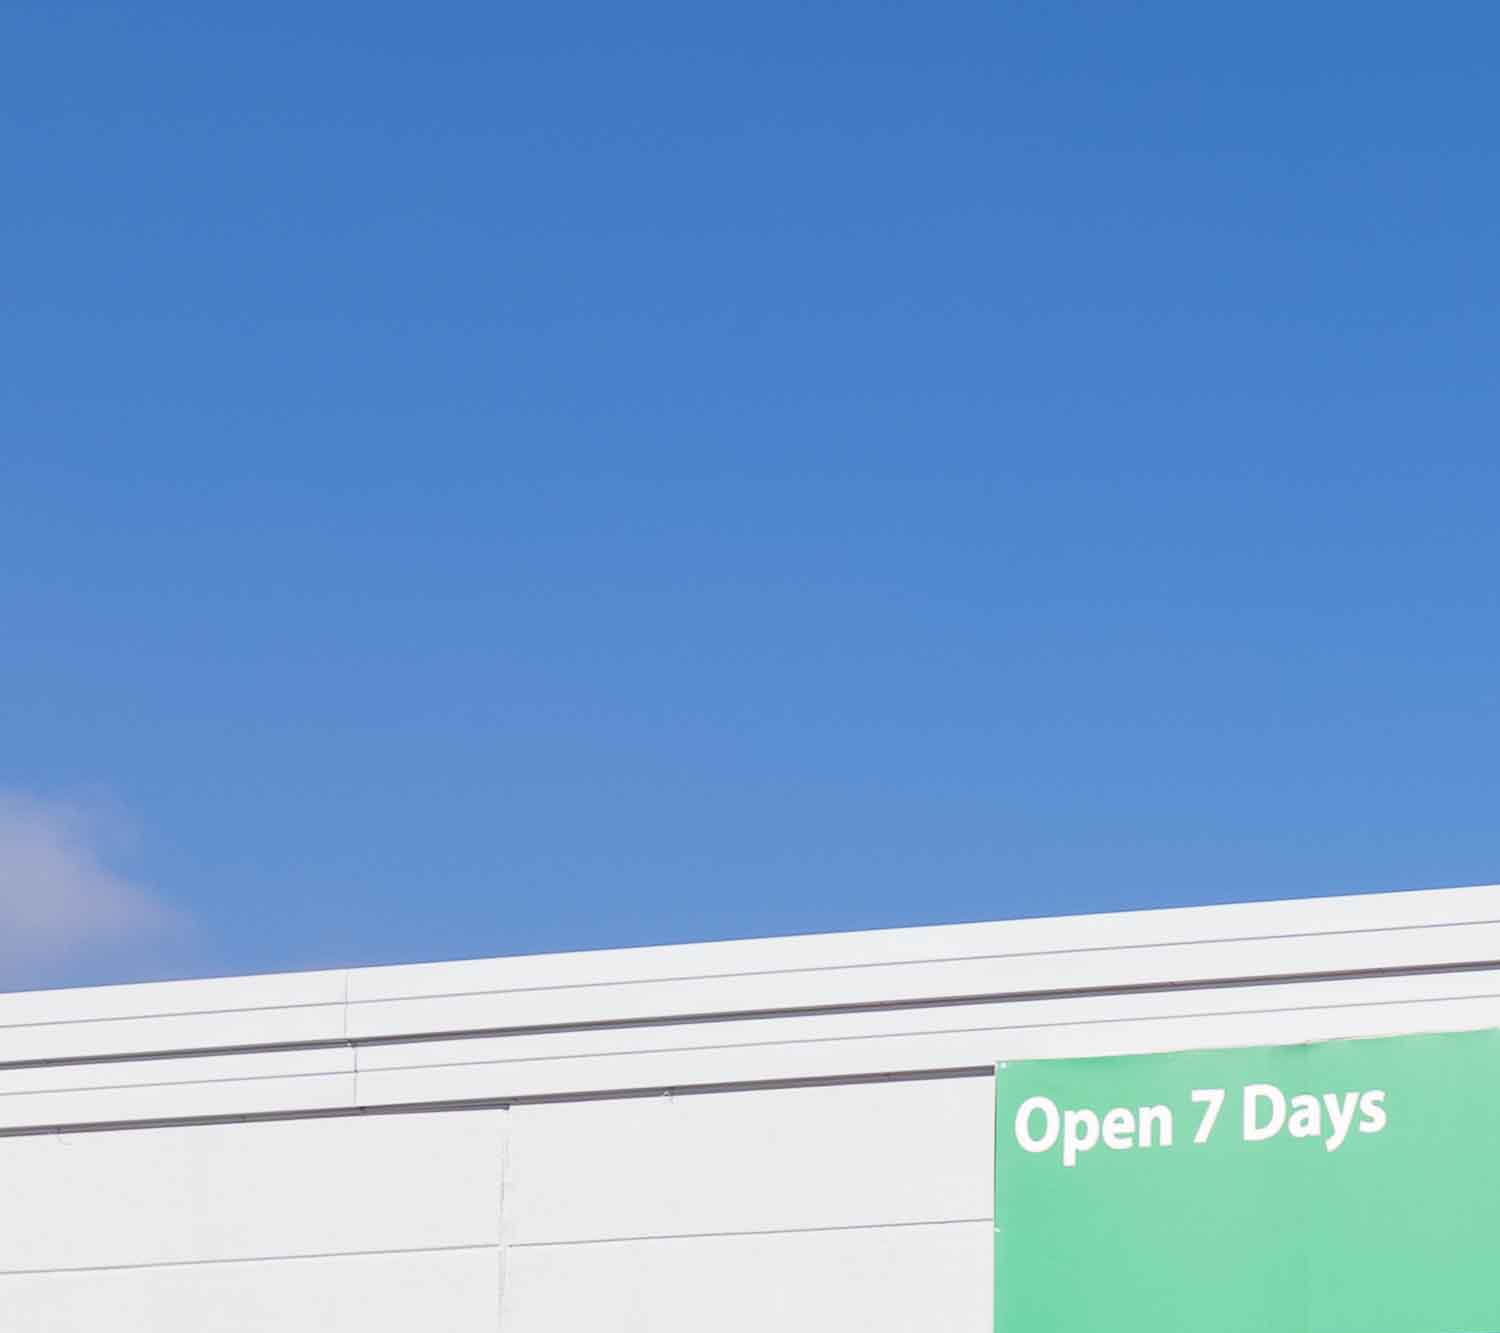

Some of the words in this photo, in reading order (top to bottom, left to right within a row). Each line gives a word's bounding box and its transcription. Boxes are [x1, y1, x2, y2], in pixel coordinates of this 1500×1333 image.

[1014, 1095, 1173, 1166] Open
[1190, 1089, 1225, 1143] 7
[1242, 1083, 1387, 1152] Days
